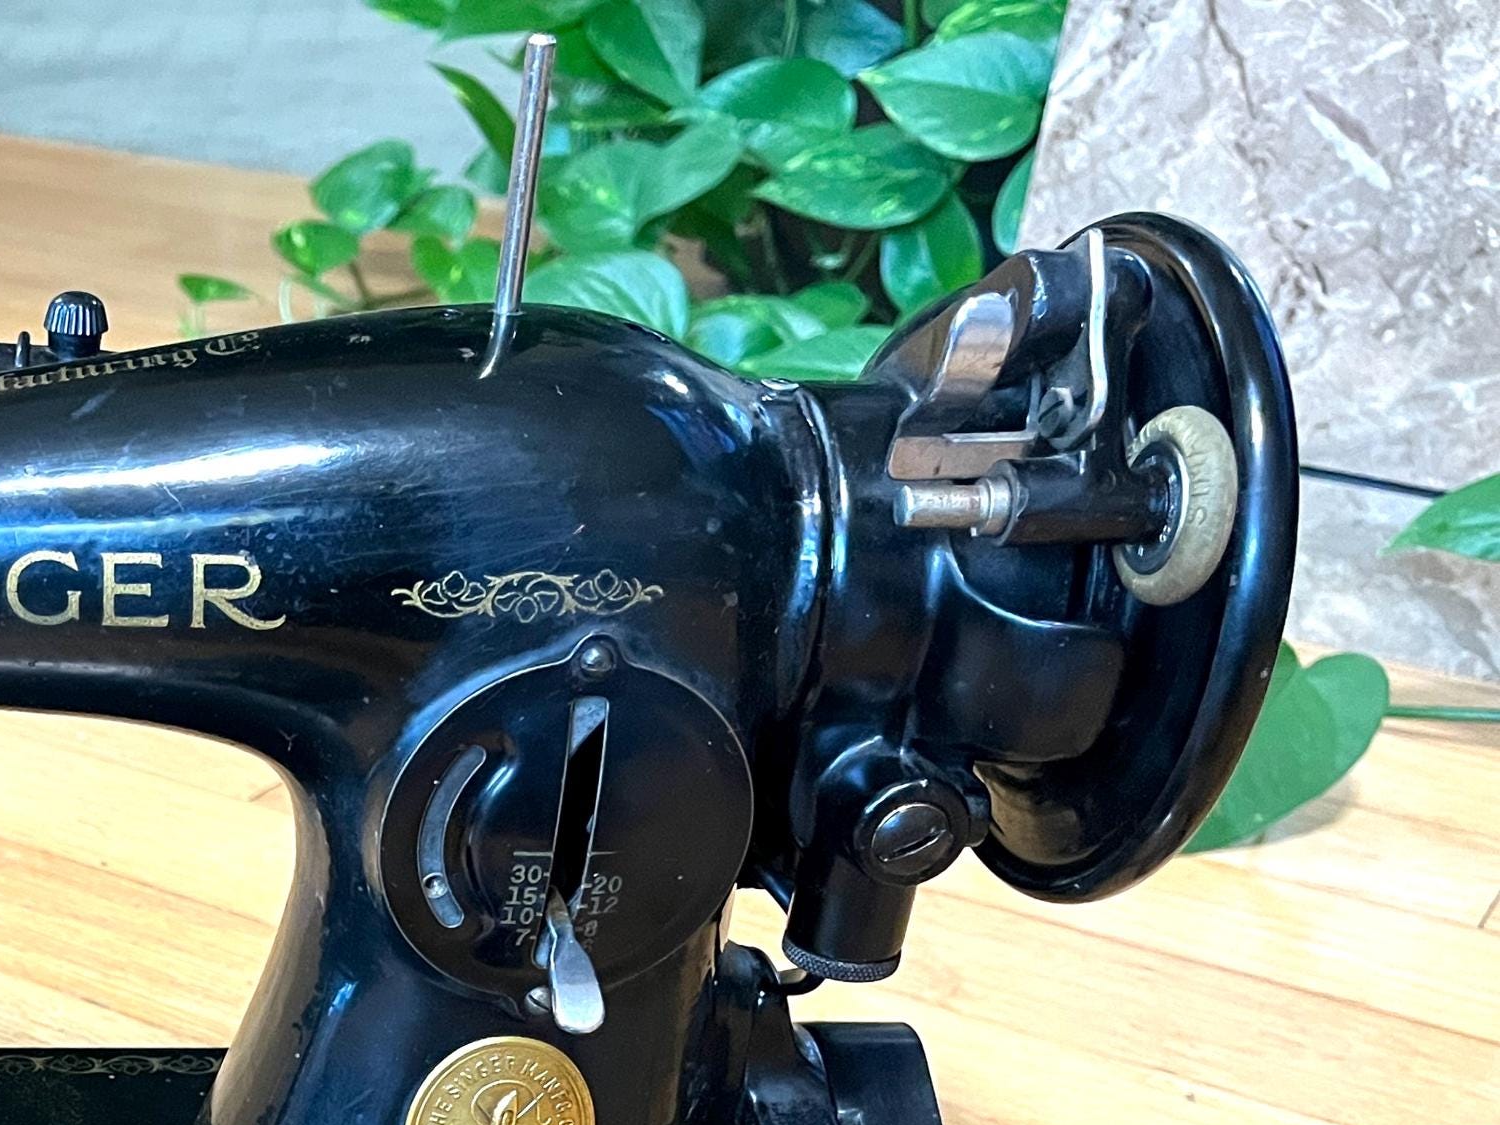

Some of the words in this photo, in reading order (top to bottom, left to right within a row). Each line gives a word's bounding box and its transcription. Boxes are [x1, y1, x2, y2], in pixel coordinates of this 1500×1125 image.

[510, 864, 542, 884] 30
[591, 876, 623, 895] 20
[505, 886, 538, 905] 15
[587, 896, 619, 915] 12
[500, 907, 535, 925] 10
[515, 928, 532, 946] 7
[584, 919, 599, 938] 8
[443, 1054, 516, 1100] SINGER
